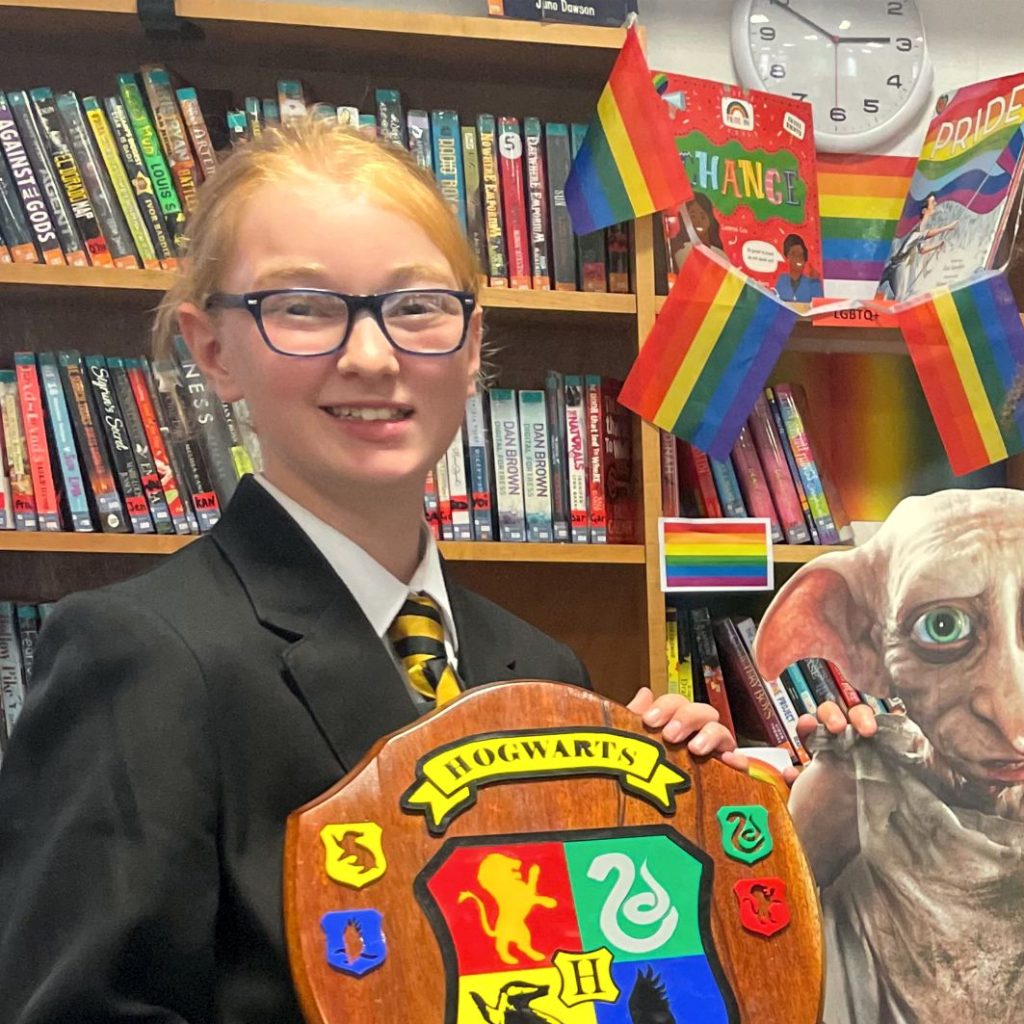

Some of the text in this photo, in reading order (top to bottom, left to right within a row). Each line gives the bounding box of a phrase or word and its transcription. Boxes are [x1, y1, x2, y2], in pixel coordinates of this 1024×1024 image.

[561, 0, 595, 16] Dawson
[887, 1, 903, 15] 2
[759, 27, 776, 41] 9
[896, 37, 912, 52] 3
[770, 64, 786, 78] 8
[886, 75, 902, 89] 4
[830, 107, 846, 122] 6
[863, 99, 880, 114] 5
[0, 120, 36, 185] AGAINST
[480, 132, 497, 182] NOWHERE
[22, 187, 40, 199] ALL
[151, 162, 172, 199] LOUIS
[26, 201, 56, 242] GODS
[72, 201, 94, 219] MAP
[485, 182, 502, 238] EMPORIUM
[530, 191, 546, 243] EMPORIUM
[90, 364, 129, 452] Sigrun's Secret
[183, 362, 214, 426] NESS
[503, 421, 521, 496] DAN BROWN
[532, 423, 548, 498] DAN BROWN
[569, 416, 584, 471] NATURALS
[754, 689, 773, 721] BOYS
[778, 698, 795, 723] PROJECT
[444, 739, 637, 780] HOGWARTS
[572, 960, 603, 994] H
